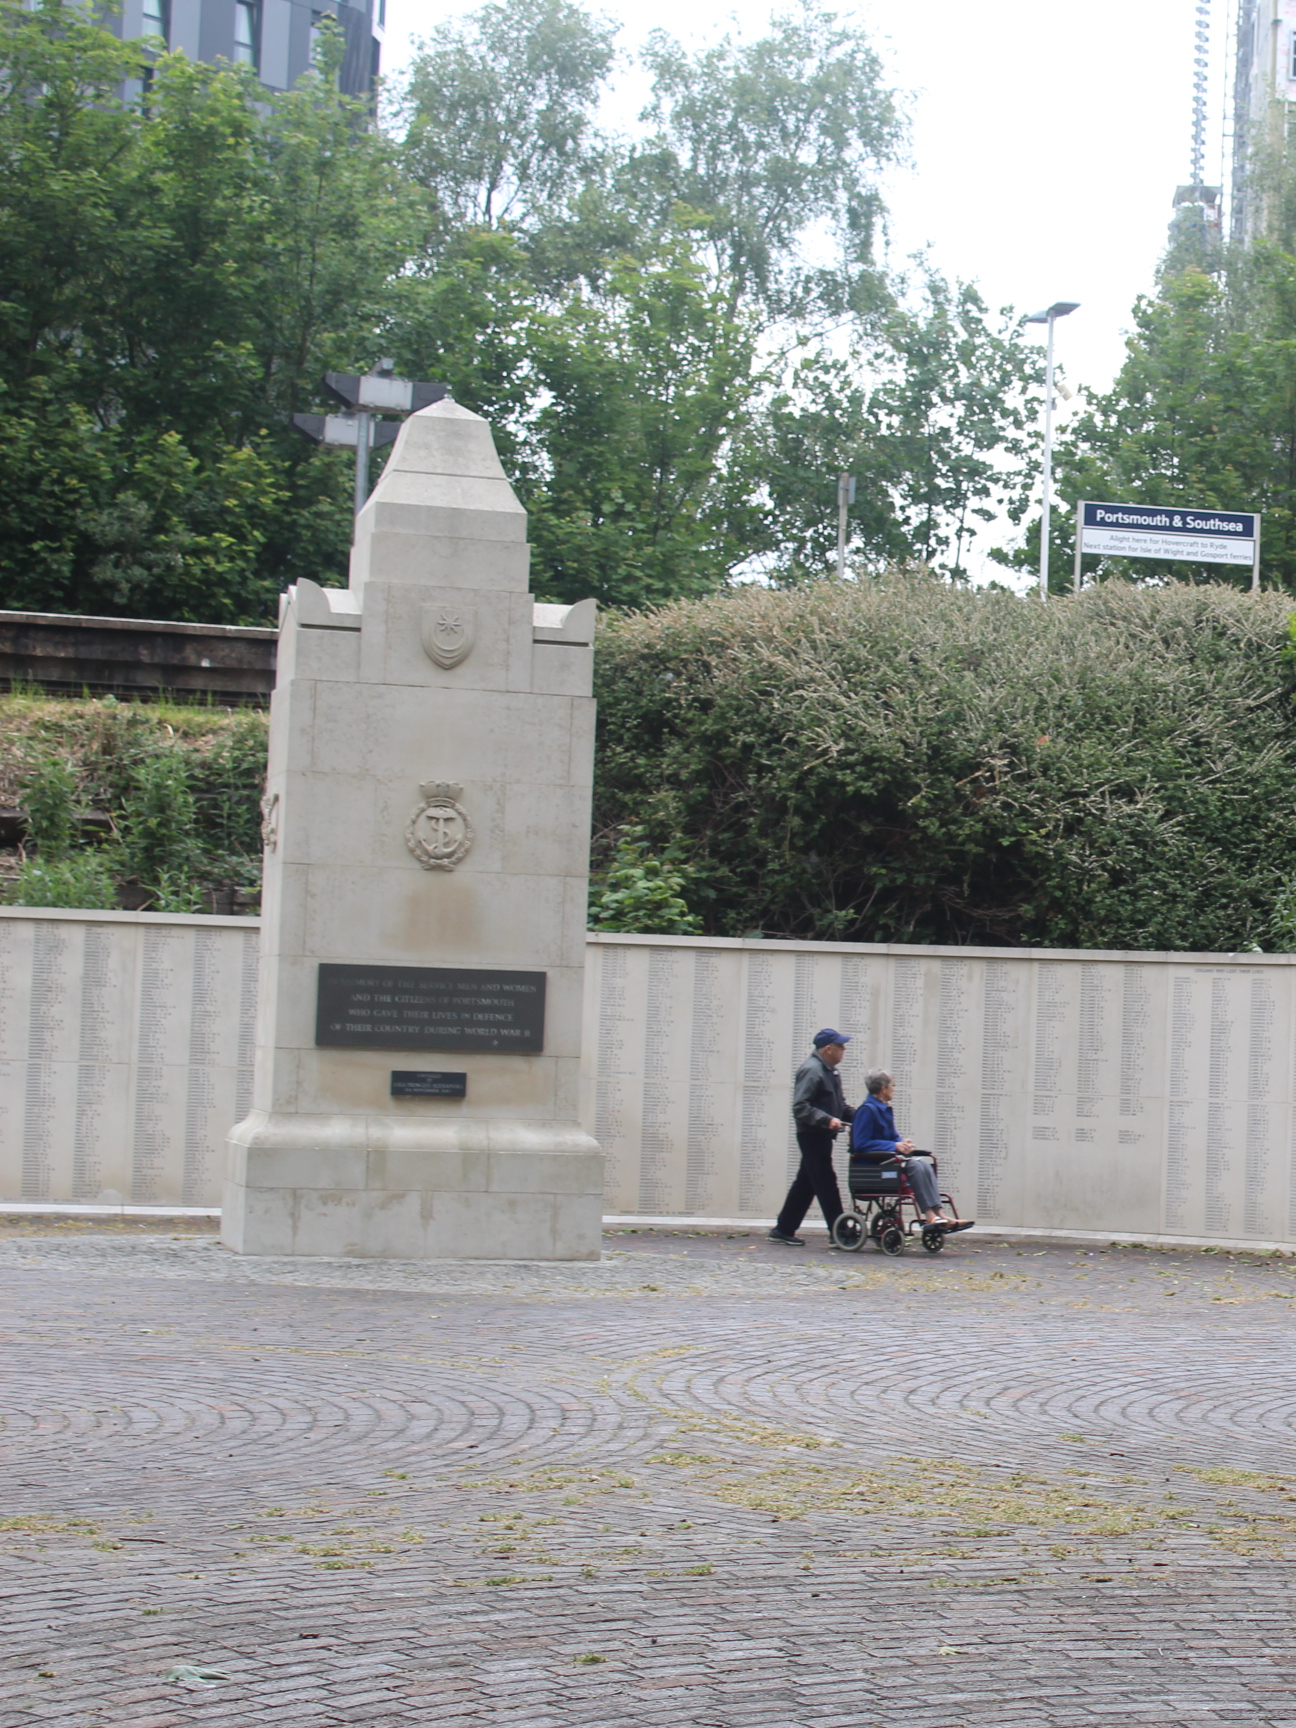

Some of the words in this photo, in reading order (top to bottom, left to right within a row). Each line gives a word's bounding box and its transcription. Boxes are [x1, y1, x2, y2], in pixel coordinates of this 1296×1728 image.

[1096, 509, 1169, 527] Portsmouth
[1172, 515, 1183, 528] &
[1186, 515, 1243, 532] Southsea
[1109, 535, 1130, 544] Alight
[1132, 536, 1147, 544] here
[1149, 537, 1160, 545] for
[1161, 538, 1199, 548] Hovercraft
[1209, 541, 1228, 550] Ryde
[1083, 541, 1101, 549] Next
[1102, 543, 1126, 551] station
[1163, 548, 1184, 557] Wight
[1200, 550, 1228, 559] Gosport
[1230, 552, 1252, 561] ferries
[457, 982, 478, 990] MEN
[480, 983, 501, 991] AND
[502, 983, 537, 993] WOMEN
[351, 993, 371, 1002] AND
[374, 993, 392, 1003] THE
[395, 994, 436, 1004] CITIZENS
[452, 997, 515, 1007] PORTSMOUTH
[348, 1008, 371, 1017] WHO
[373, 1008, 398, 1018] GAVE
[402, 1010, 430, 1019] THEIR
[432, 1011, 458, 1020] LIVES
[460, 1012, 471, 1020] IN
[473, 1012, 514, 1022] DEFENCE
[330, 1022, 342, 1031] OF
[345, 1023, 373, 1032] THEIR
[374, 1024, 421, 1034] COUNTRY
[424, 1026, 461, 1035] DURING
[464, 1027, 498, 1036] WORLD
[500, 1028, 521, 1037] WAR
